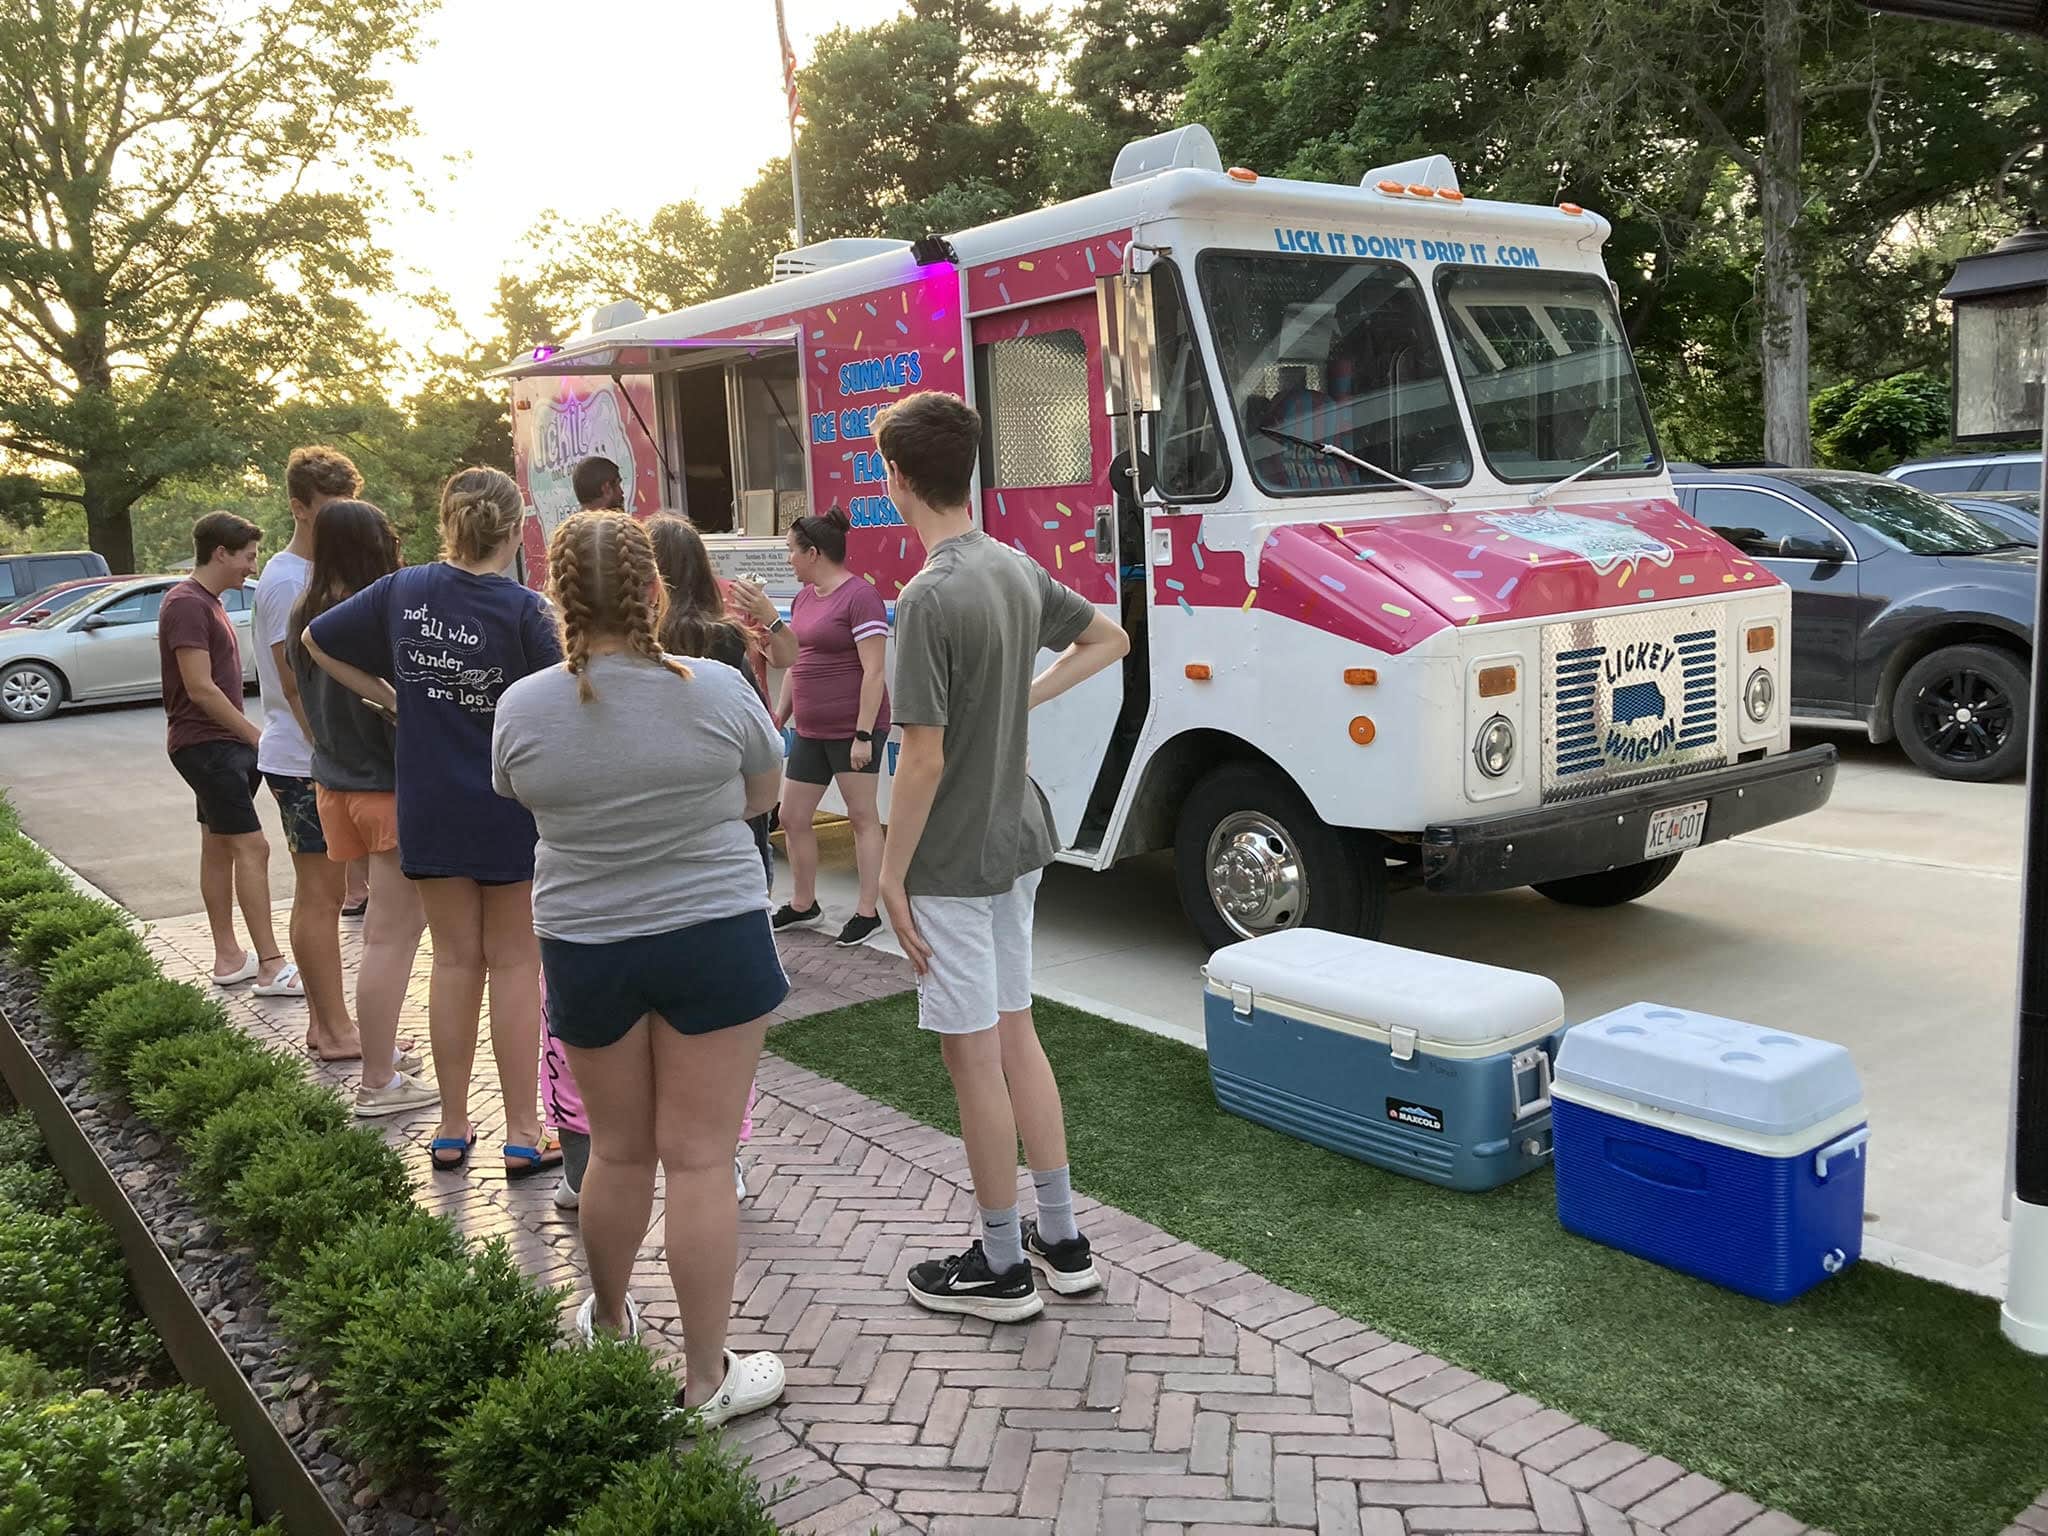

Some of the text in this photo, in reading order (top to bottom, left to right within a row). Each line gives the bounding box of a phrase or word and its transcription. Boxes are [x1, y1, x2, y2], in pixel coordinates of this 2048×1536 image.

[1274, 228, 1540, 267] LICK IT DON'T DRIP IT .COM
[840, 351, 922, 396] SUNDAE'S
[811, 402, 893, 445] ICE CRE
[403, 603, 429, 622] not
[420, 617, 479, 646] all who
[1604, 641, 1676, 685] LICKEY
[427, 686, 454, 700] are
[1604, 717, 1677, 764] WAGON
[1648, 818, 1675, 849] XE4
[1398, 1112, 1441, 1129] MAXCOLD
